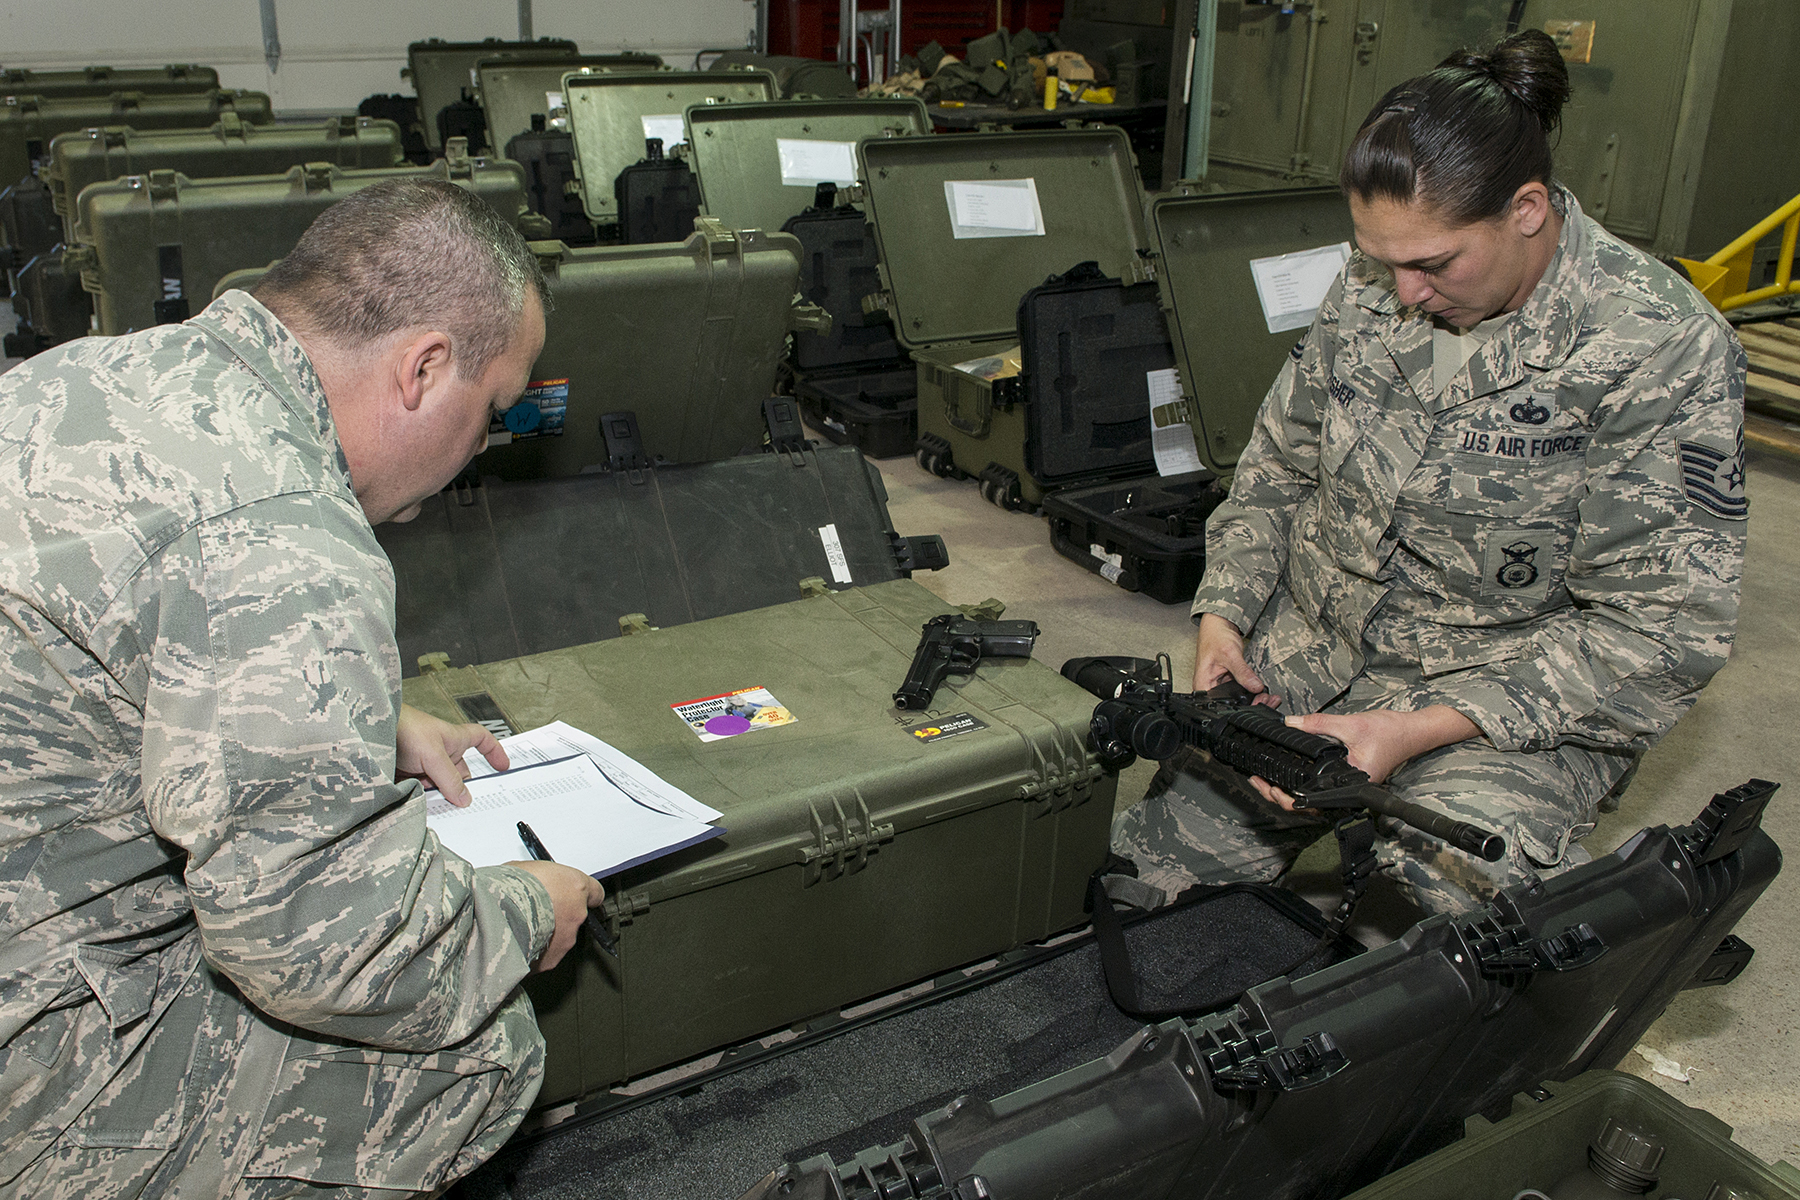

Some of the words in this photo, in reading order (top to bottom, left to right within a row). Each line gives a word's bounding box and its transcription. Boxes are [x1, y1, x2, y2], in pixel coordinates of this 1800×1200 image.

[1462, 431, 1491, 454] U.S.
[1495, 436, 1526, 458] AIR
[1530, 435, 1586, 458] FORCE
[825, 544, 837, 566] ELLIOT
[833, 541, 841, 552] 307
[837, 554, 845, 567] SFS
[732, 686, 761, 695] PELICAN
[677, 699, 724, 713] Watertight
[682, 706, 724, 718] Protector
[687, 714, 710, 722] Case
[939, 718, 971, 730] PELICAN
